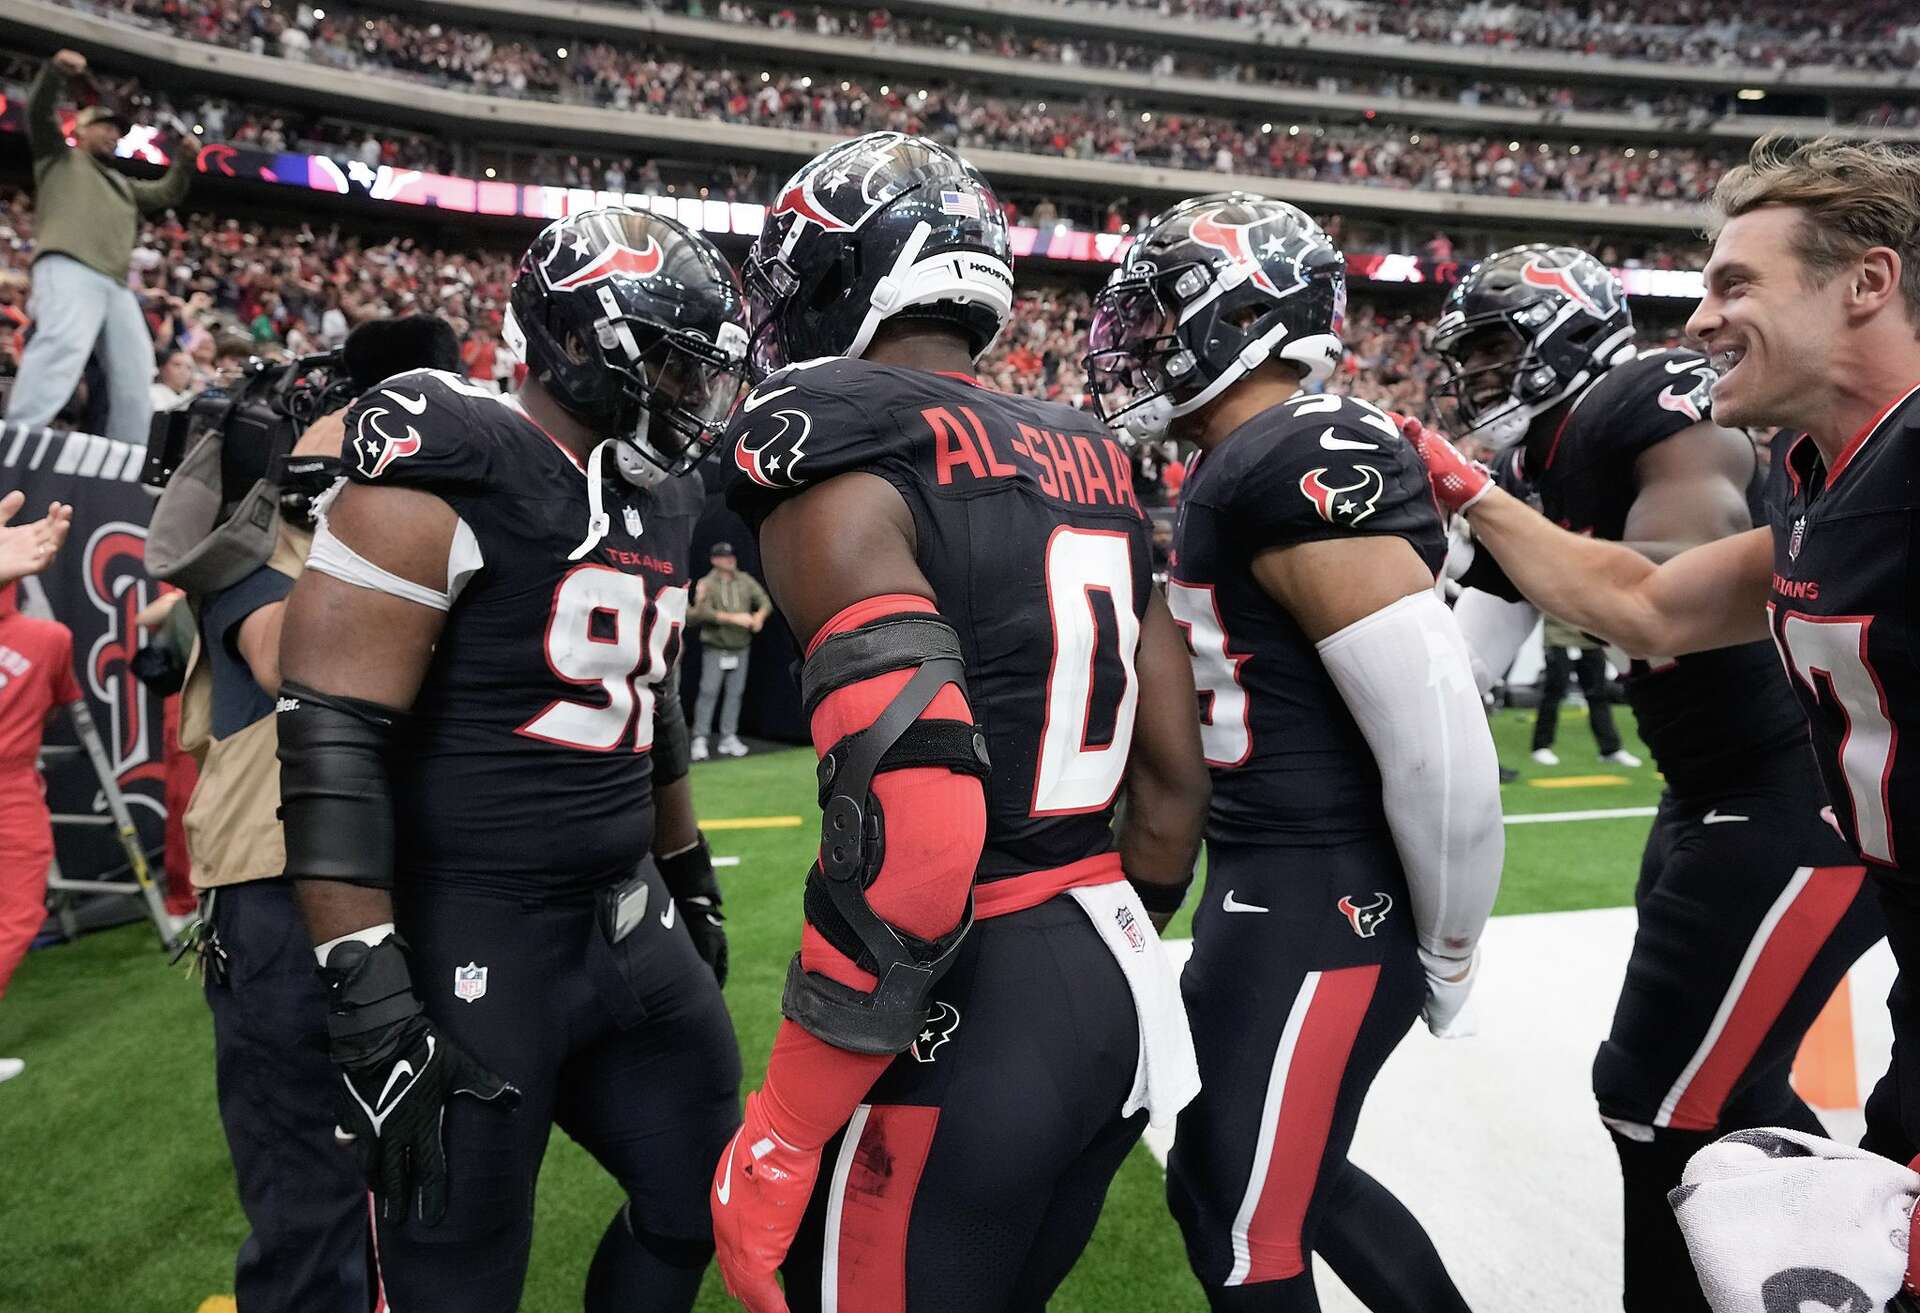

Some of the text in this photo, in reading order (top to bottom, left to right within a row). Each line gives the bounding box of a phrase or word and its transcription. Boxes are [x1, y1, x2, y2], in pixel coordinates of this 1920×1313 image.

[605, 547, 674, 575] TEXANS
[1029, 524, 1141, 818] 0
[1766, 600, 1899, 870] 7
